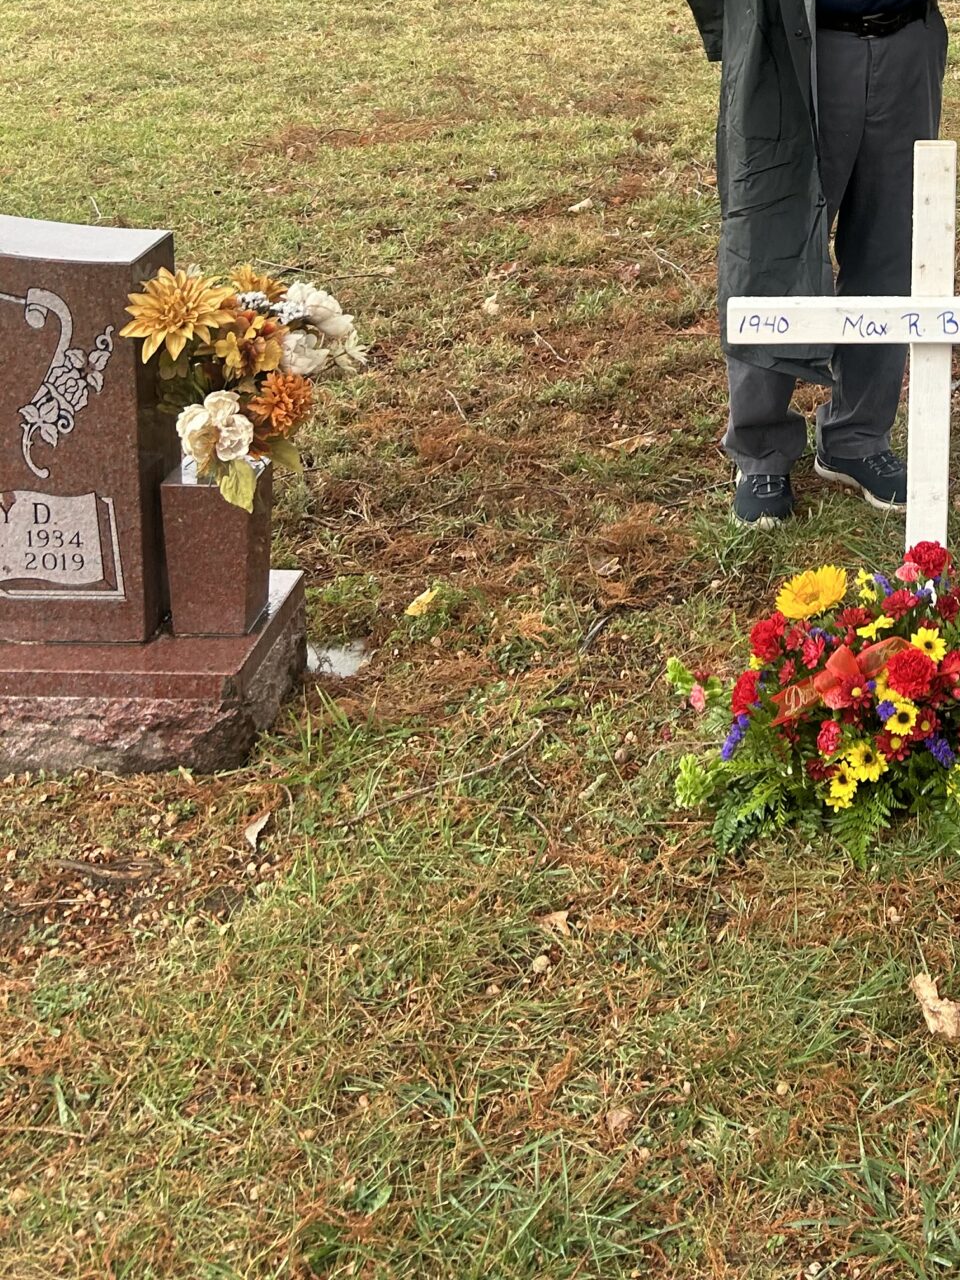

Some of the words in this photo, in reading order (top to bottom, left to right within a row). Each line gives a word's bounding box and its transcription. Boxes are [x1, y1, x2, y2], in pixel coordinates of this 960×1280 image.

[739, 314, 789, 334] 1940
[843, 314, 888, 338] Max
[27, 529, 84, 548] 1934
[24, 552, 85, 572] 2019
